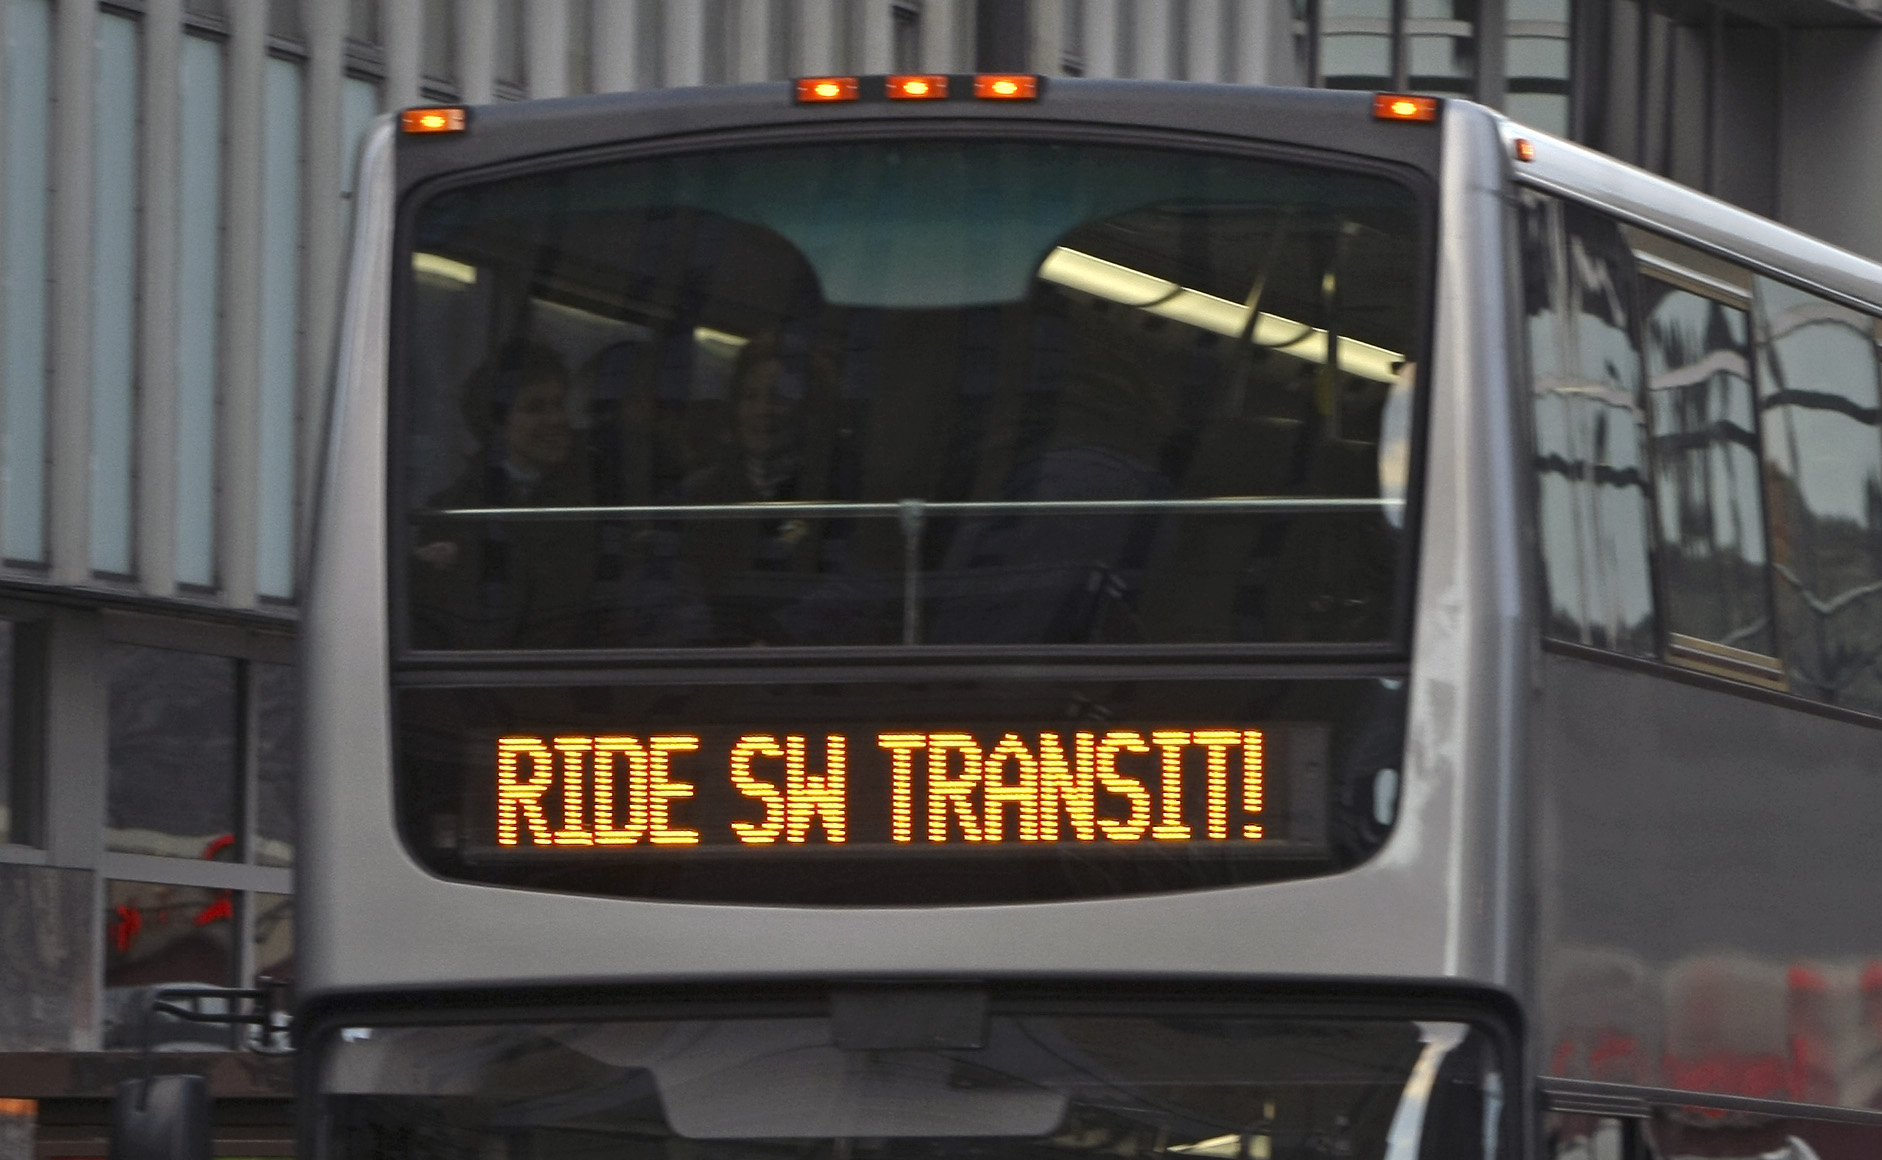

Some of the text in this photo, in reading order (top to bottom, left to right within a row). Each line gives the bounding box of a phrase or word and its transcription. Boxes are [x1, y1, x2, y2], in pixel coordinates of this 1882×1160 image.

[498, 730, 1262, 846] RIDE SW TRANSIT!
